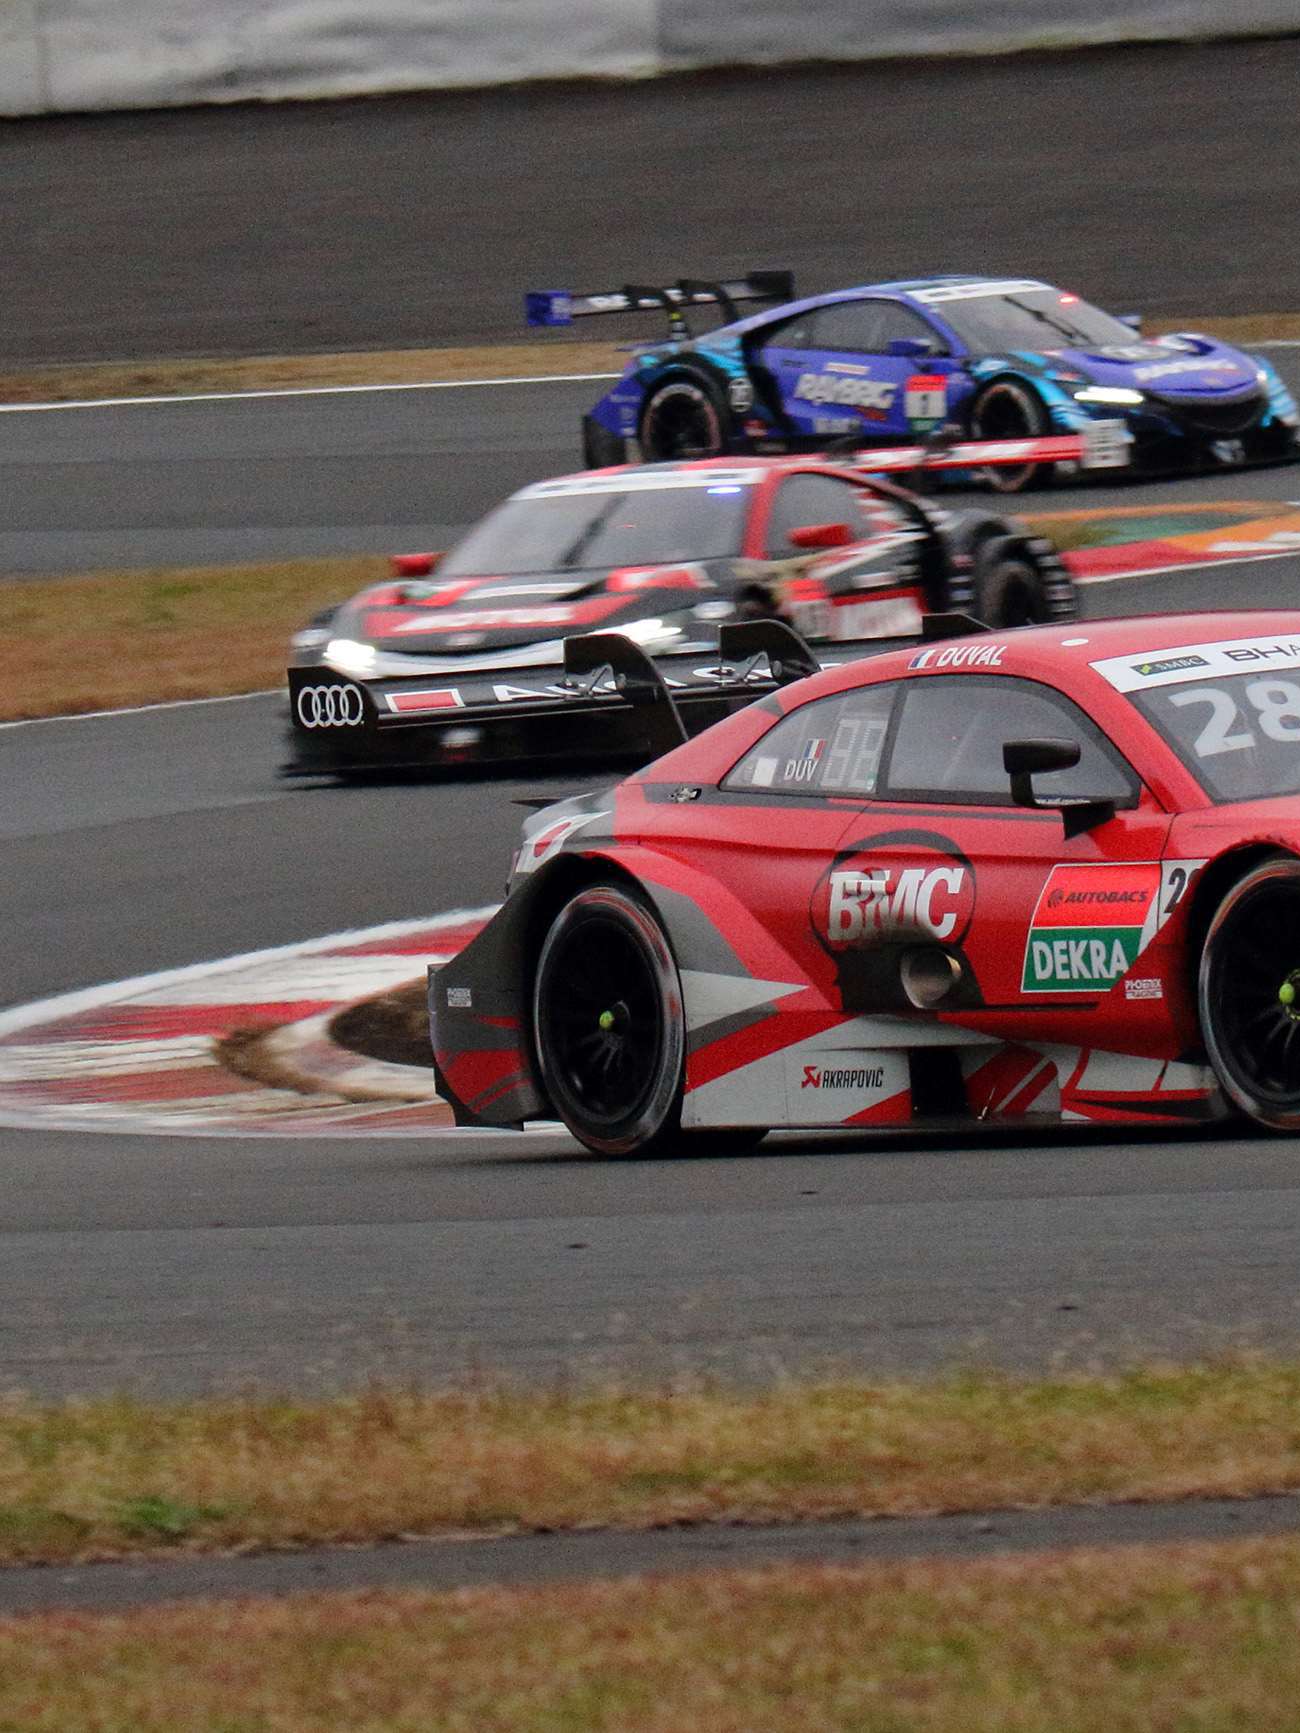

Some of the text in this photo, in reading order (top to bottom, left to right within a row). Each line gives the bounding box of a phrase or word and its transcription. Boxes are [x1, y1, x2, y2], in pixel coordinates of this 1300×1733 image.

[935, 645, 1007, 667] DUVAL
[783, 759, 819, 781] DUV
[828, 866, 966, 941] BMC
[1065, 889, 1149, 904] AUTOBACS
[1031, 937, 1130, 981] DEKRA
